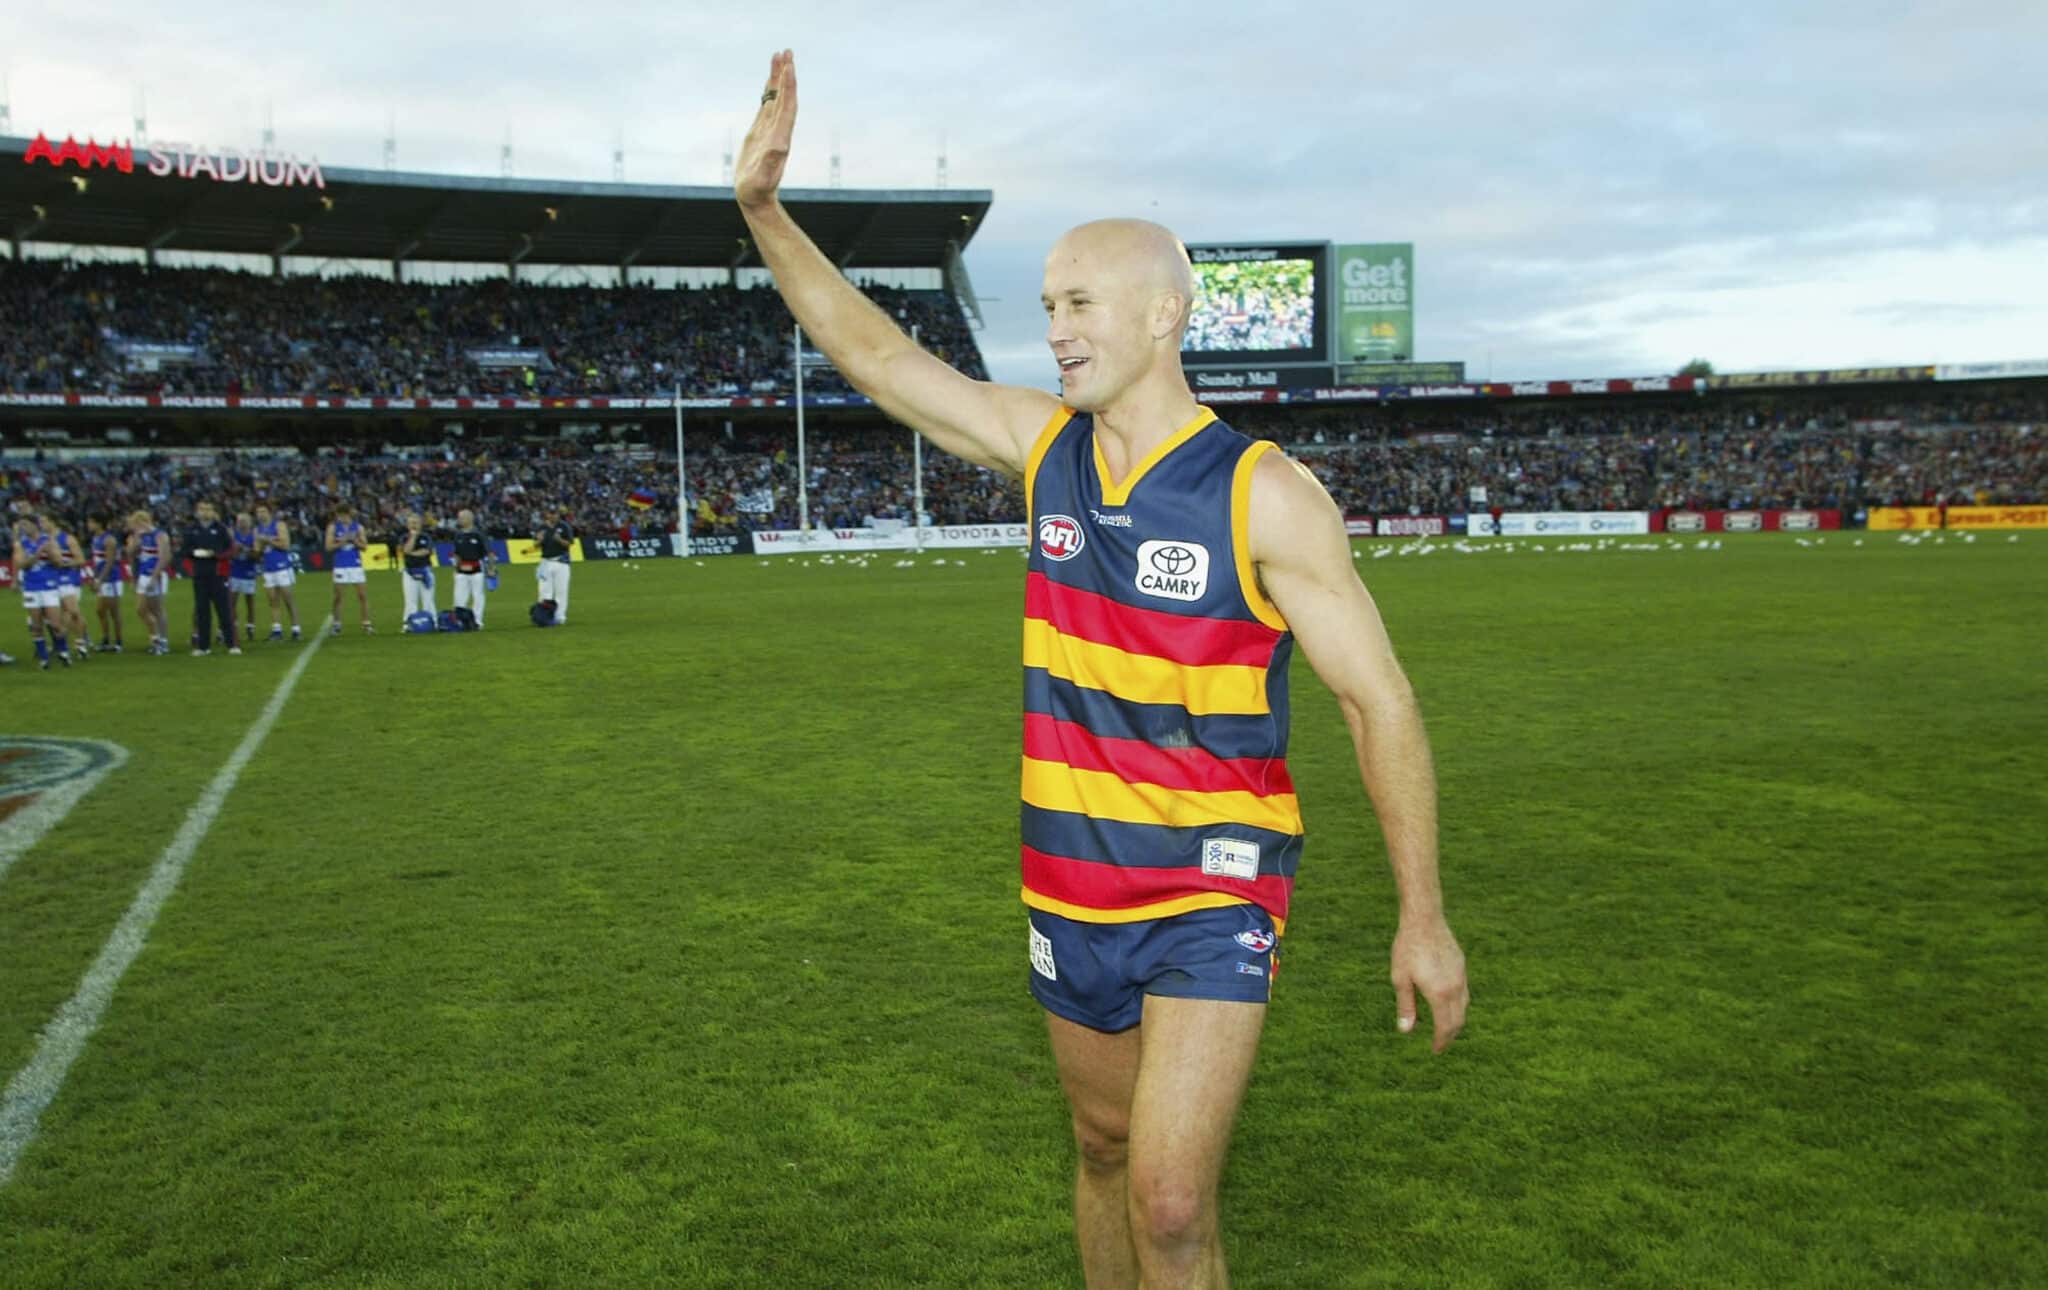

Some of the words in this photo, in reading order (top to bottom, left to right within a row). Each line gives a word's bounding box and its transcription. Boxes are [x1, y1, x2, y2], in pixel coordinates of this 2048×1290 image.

[148, 144, 325, 189] STADIUM
[1343, 256, 1407, 288] Get
[1343, 287, 1407, 303] more
[1196, 372, 1245, 387] Sunday
[1247, 371, 1277, 385] Mail
[240, 397, 302, 408] HOLDEN
[939, 527, 1001, 540] TOYOTA
[1040, 524, 1077, 551] AFL
[1141, 574, 1200, 595] CAMRY
